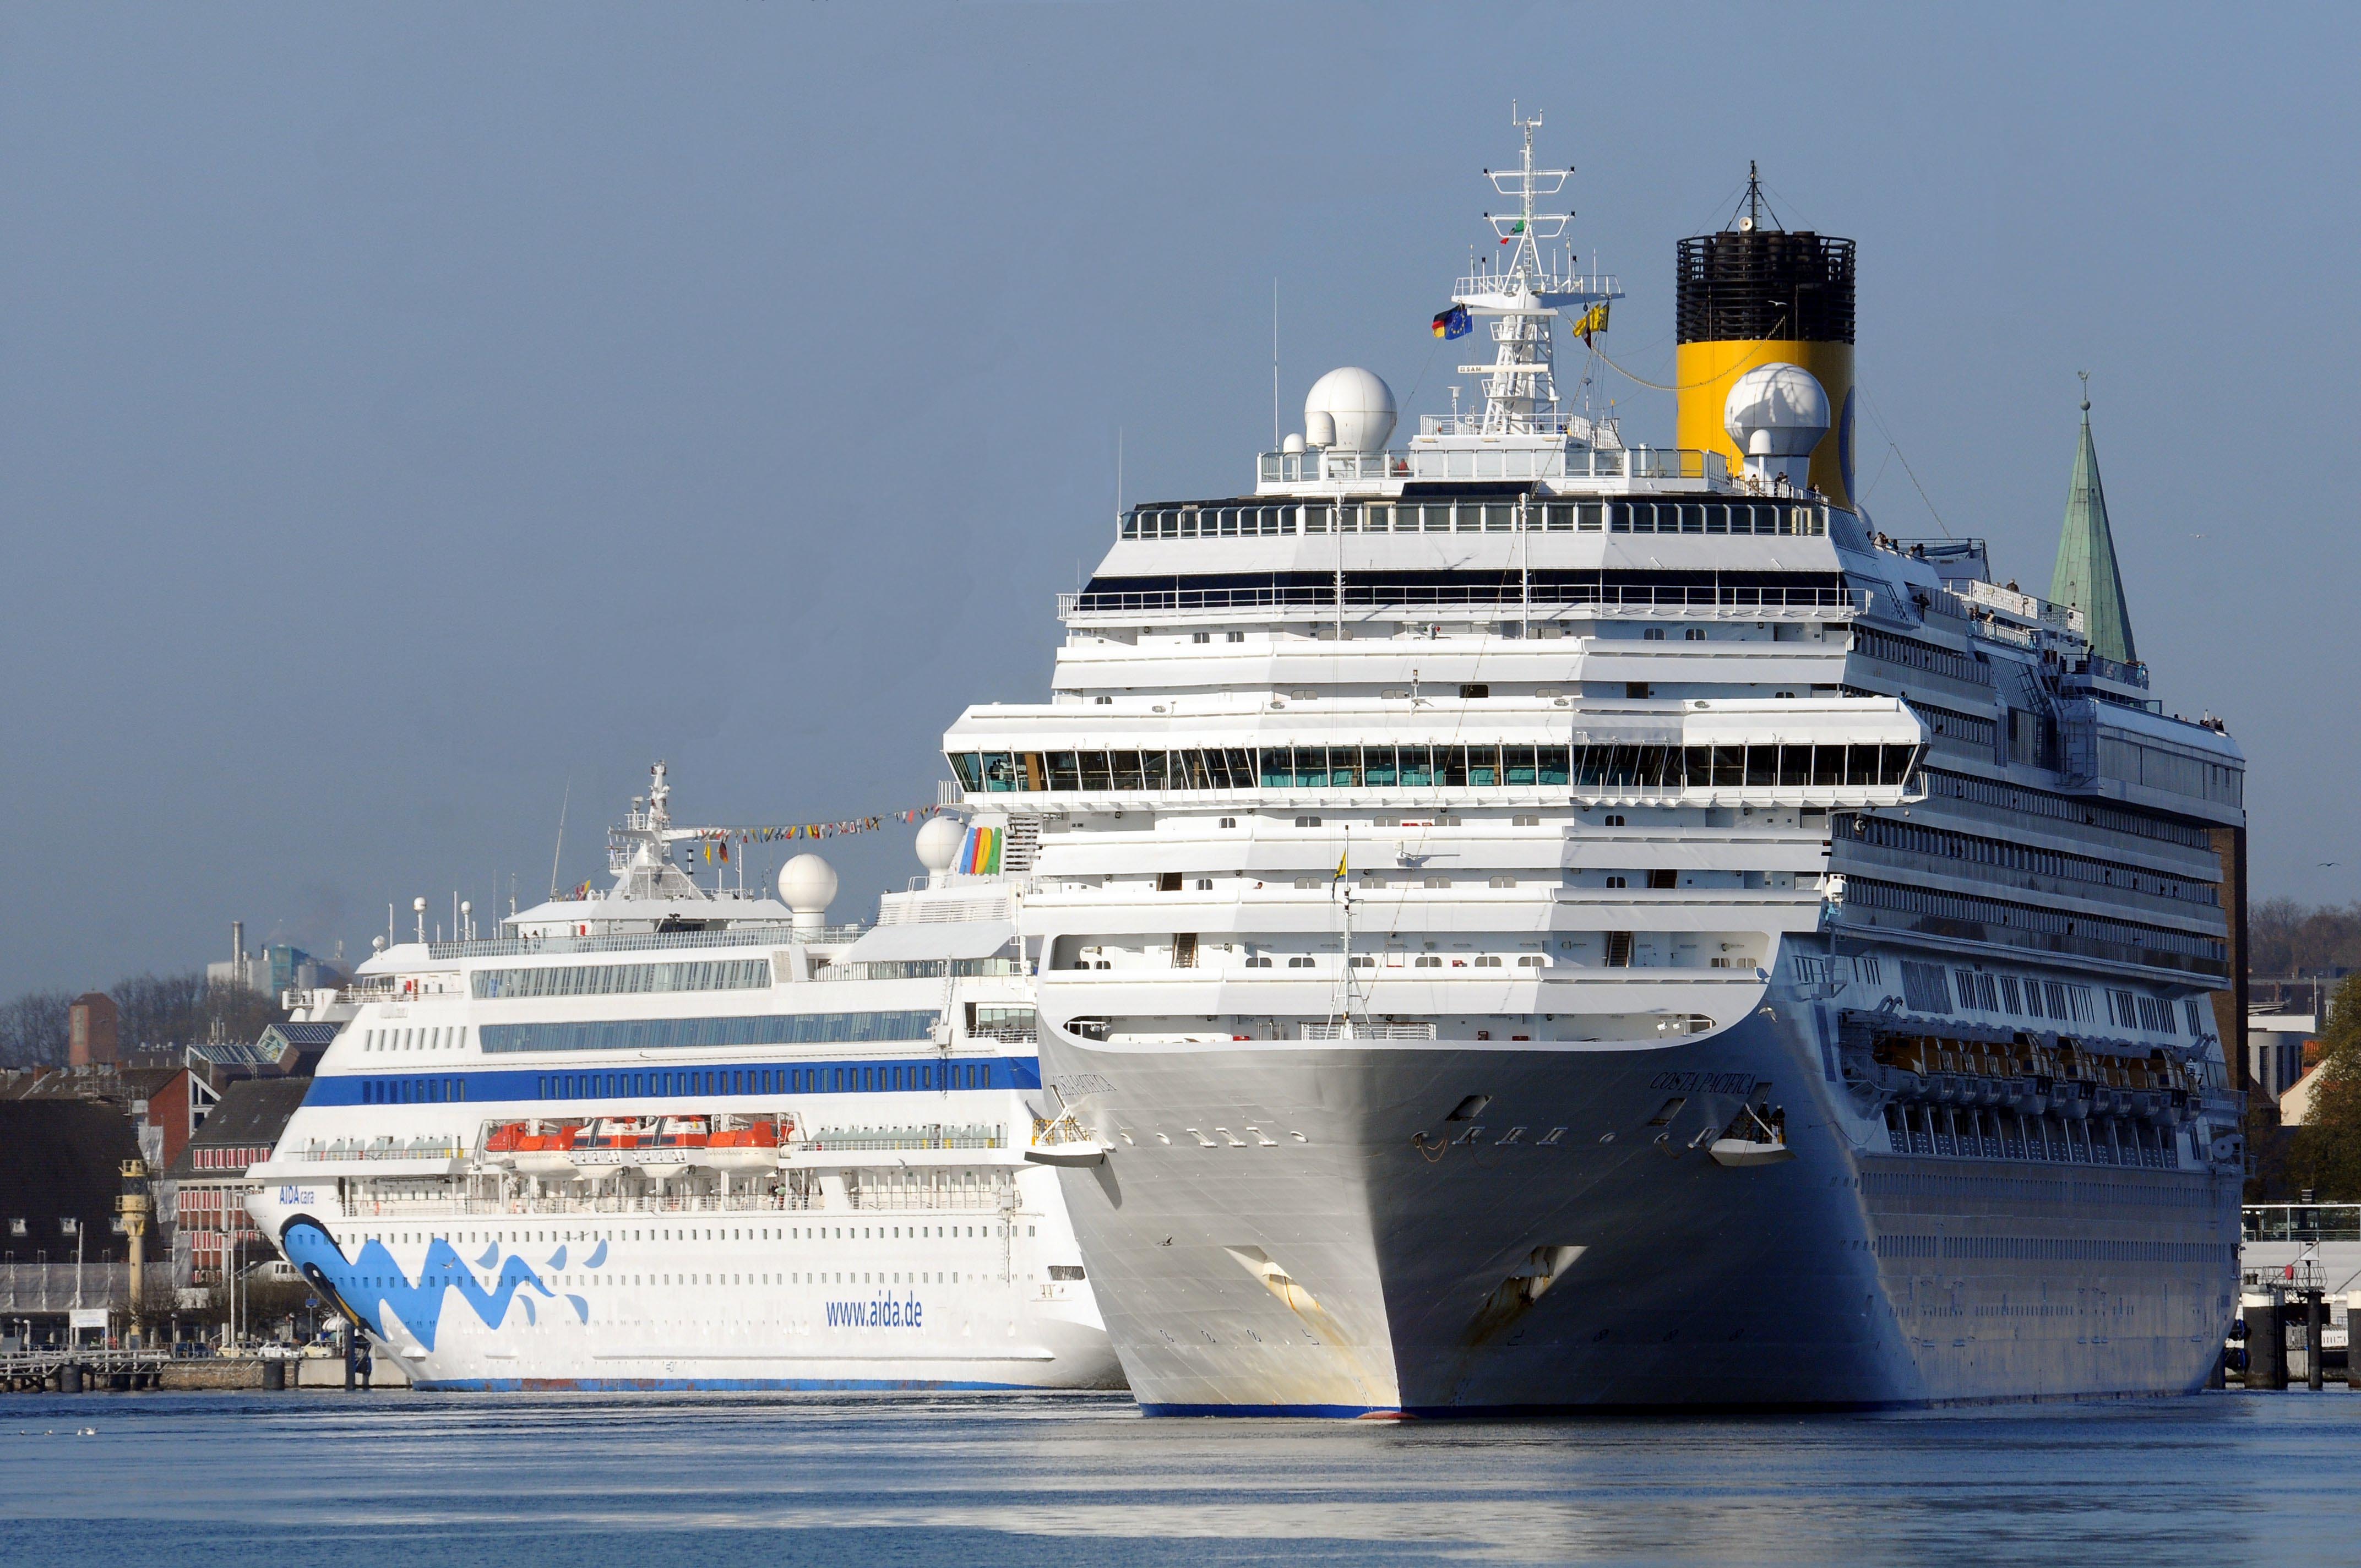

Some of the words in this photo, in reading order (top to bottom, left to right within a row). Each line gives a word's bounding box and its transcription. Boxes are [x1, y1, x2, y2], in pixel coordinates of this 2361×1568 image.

[958, 827, 1002, 875] AIDA
[1650, 1071, 1700, 1091] COSTA
[1696, 1072, 1756, 1095] PACIFICA
[826, 1290, 922, 1327] www.aida.de
